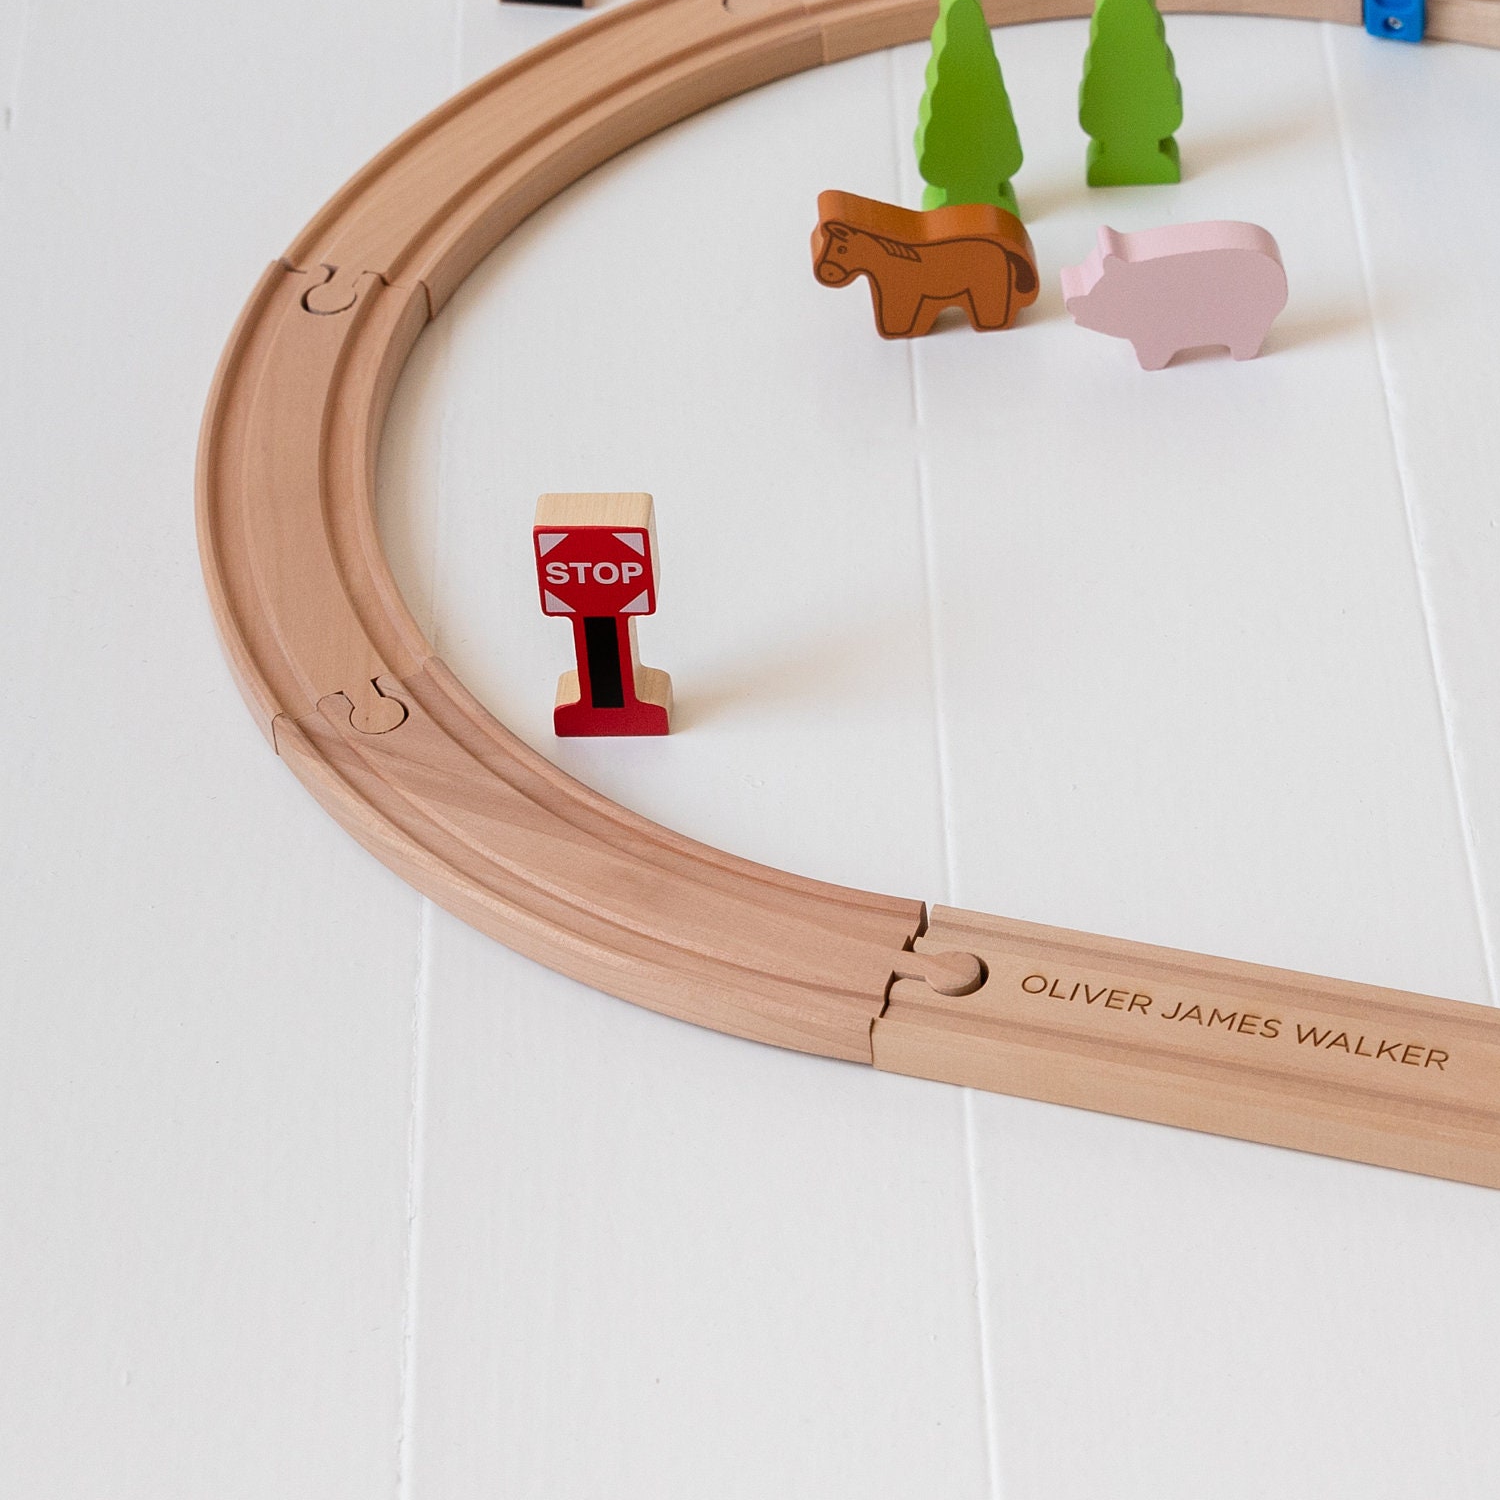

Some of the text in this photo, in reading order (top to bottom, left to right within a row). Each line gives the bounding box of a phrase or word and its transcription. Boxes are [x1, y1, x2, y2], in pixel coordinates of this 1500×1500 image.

[545, 562, 643, 585] STOP
[1021, 974, 1450, 1071] OLIVER JAMES WALKER
